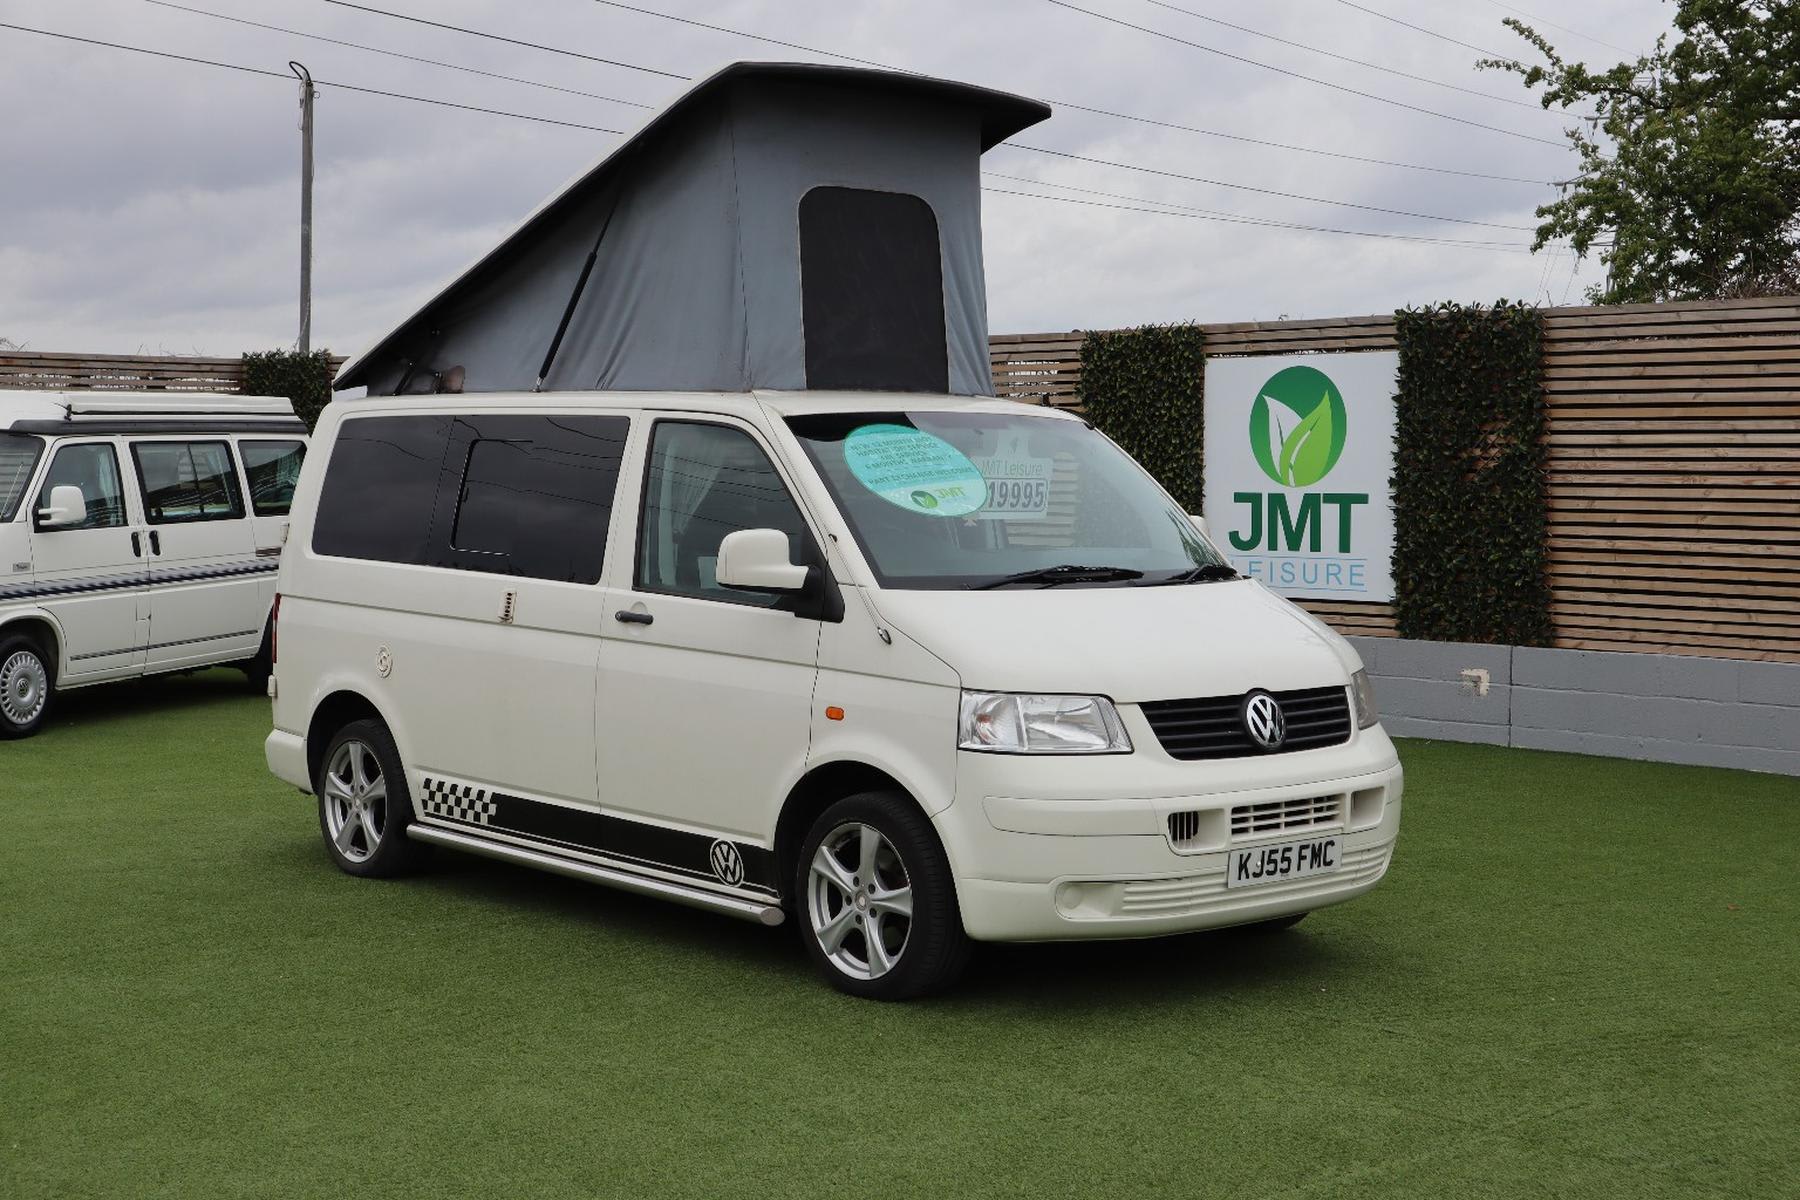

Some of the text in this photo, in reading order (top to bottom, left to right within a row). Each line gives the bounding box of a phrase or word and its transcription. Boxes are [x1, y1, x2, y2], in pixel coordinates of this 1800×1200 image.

[1005, 459, 1043, 476] Leisure
[988, 481, 1045, 508] 19995
[1228, 491, 1370, 554] JMT
[1230, 559, 1366, 588] EISURE
[1238, 839, 1336, 881] KJ55 FMC
